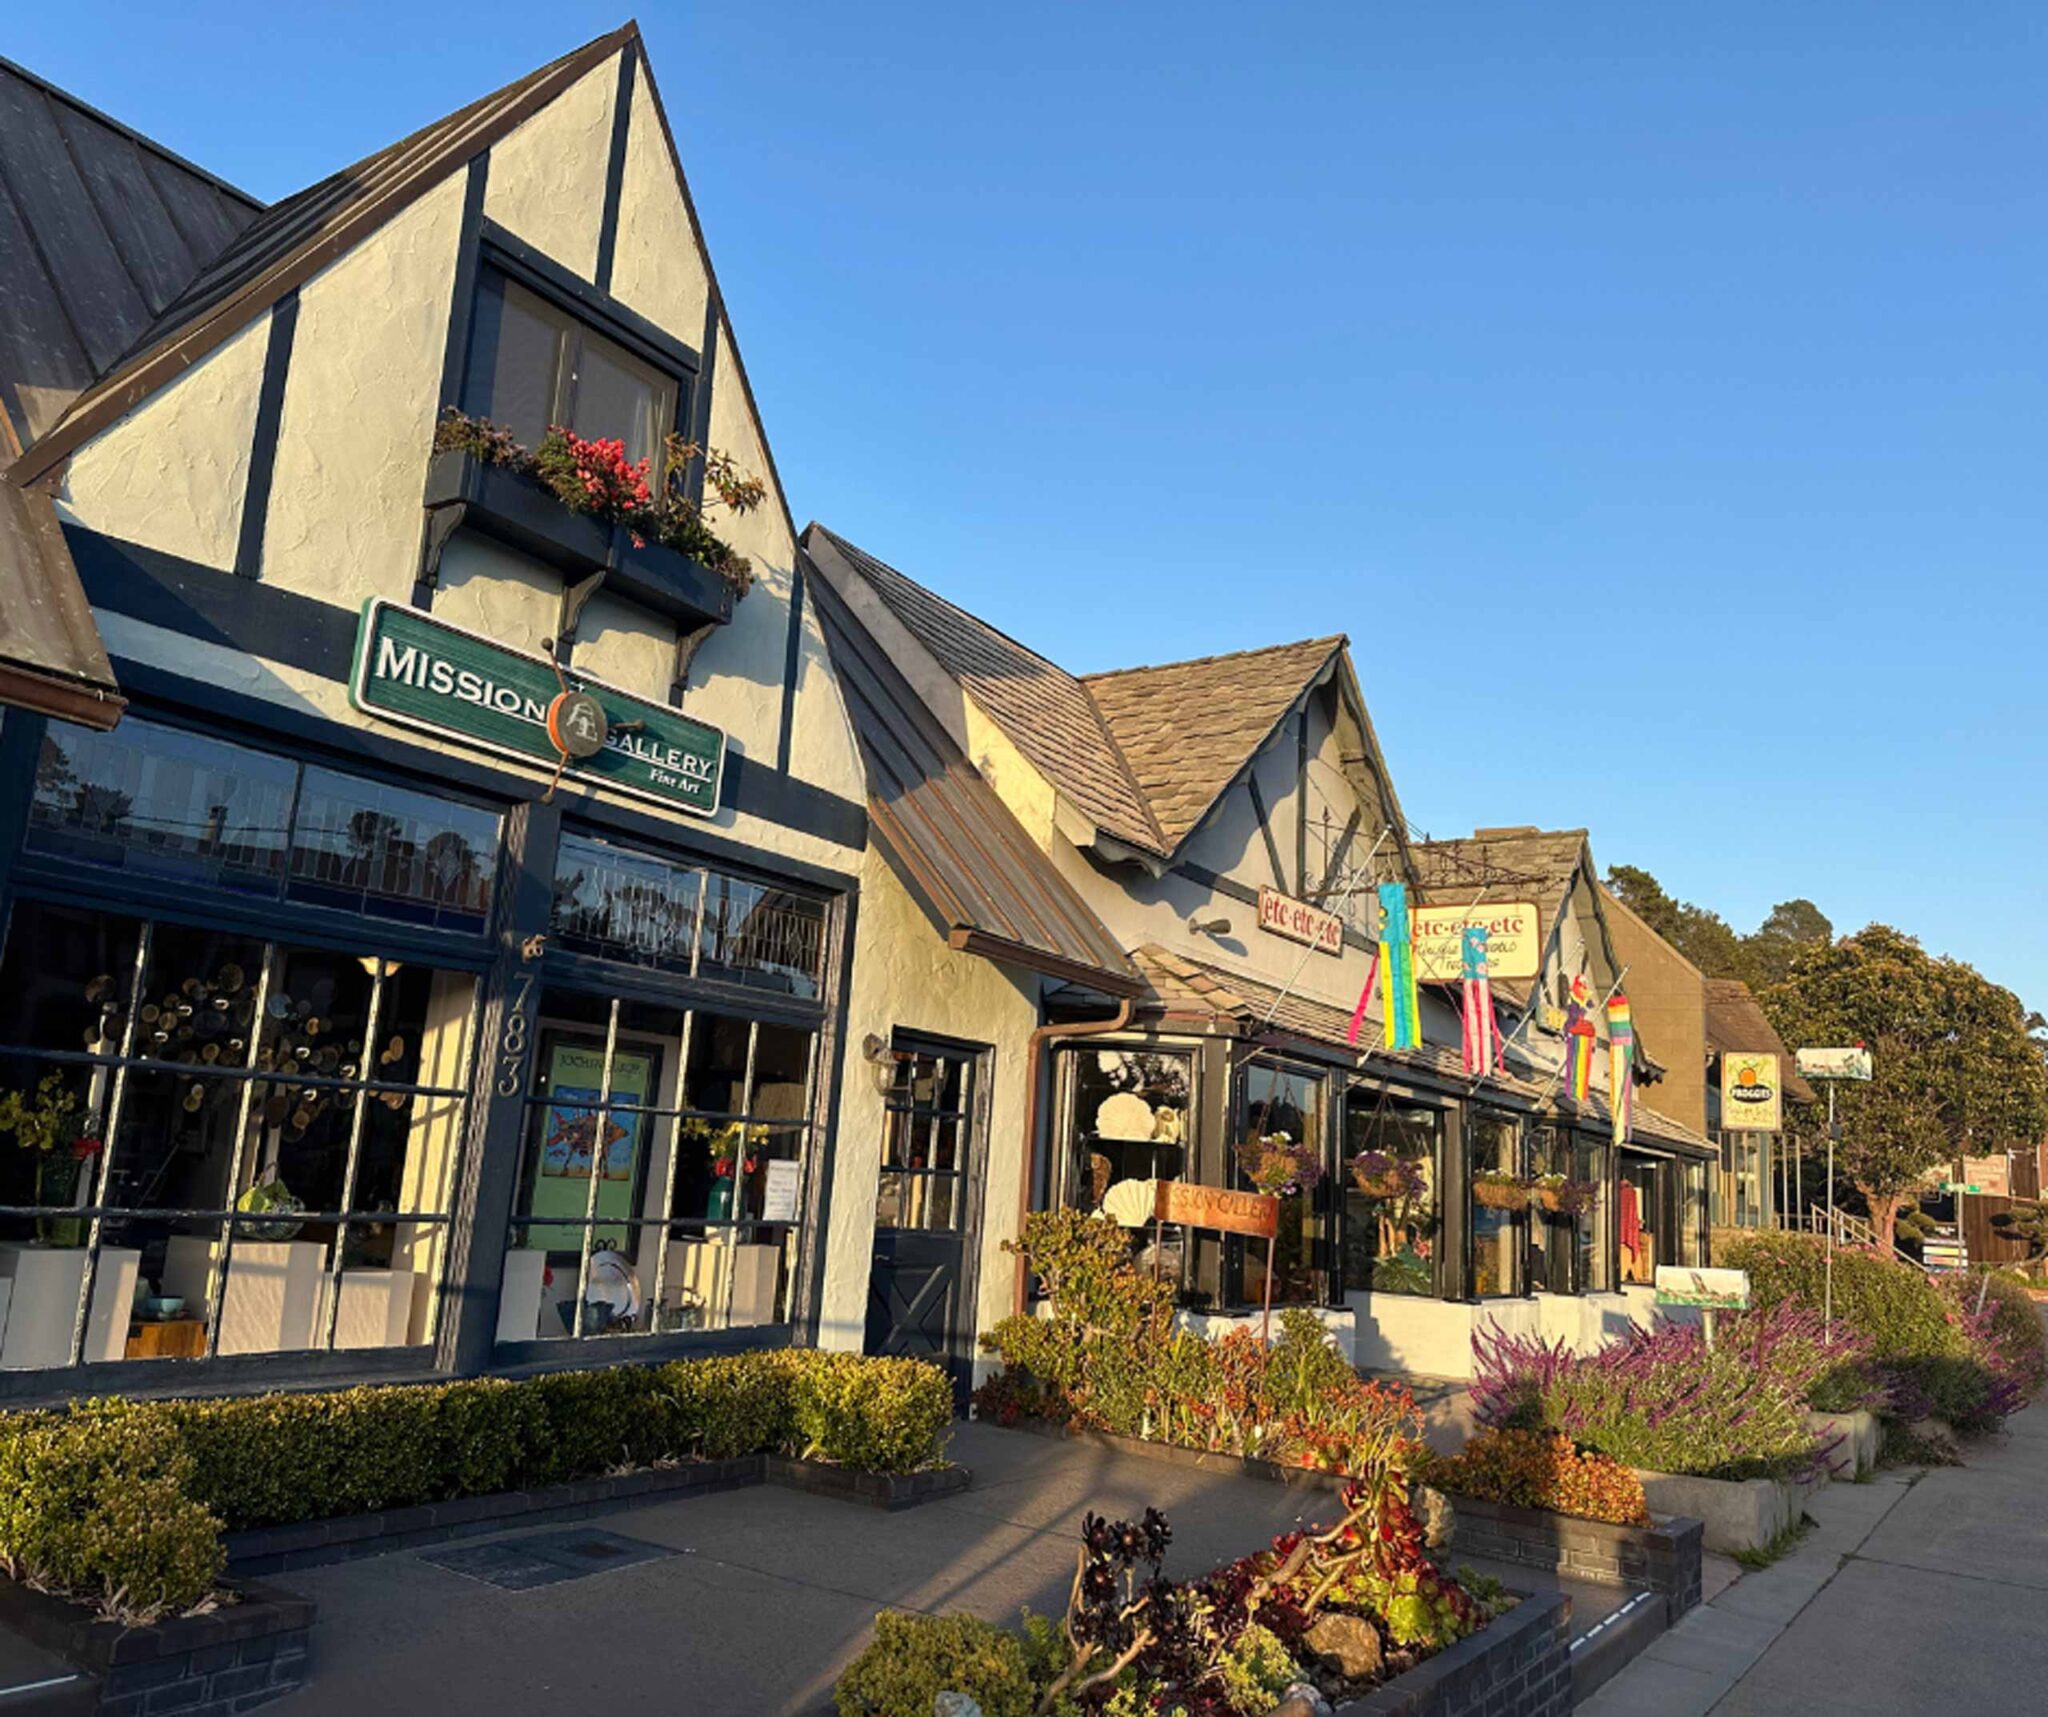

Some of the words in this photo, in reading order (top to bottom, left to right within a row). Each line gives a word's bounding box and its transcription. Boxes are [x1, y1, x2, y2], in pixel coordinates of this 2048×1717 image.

[375, 635, 546, 721] MISSION
[604, 727, 711, 777] GALLERY
[650, 767, 676, 787] Fine
[678, 778, 700, 794] Art
[498, 970, 534, 1098] 783
